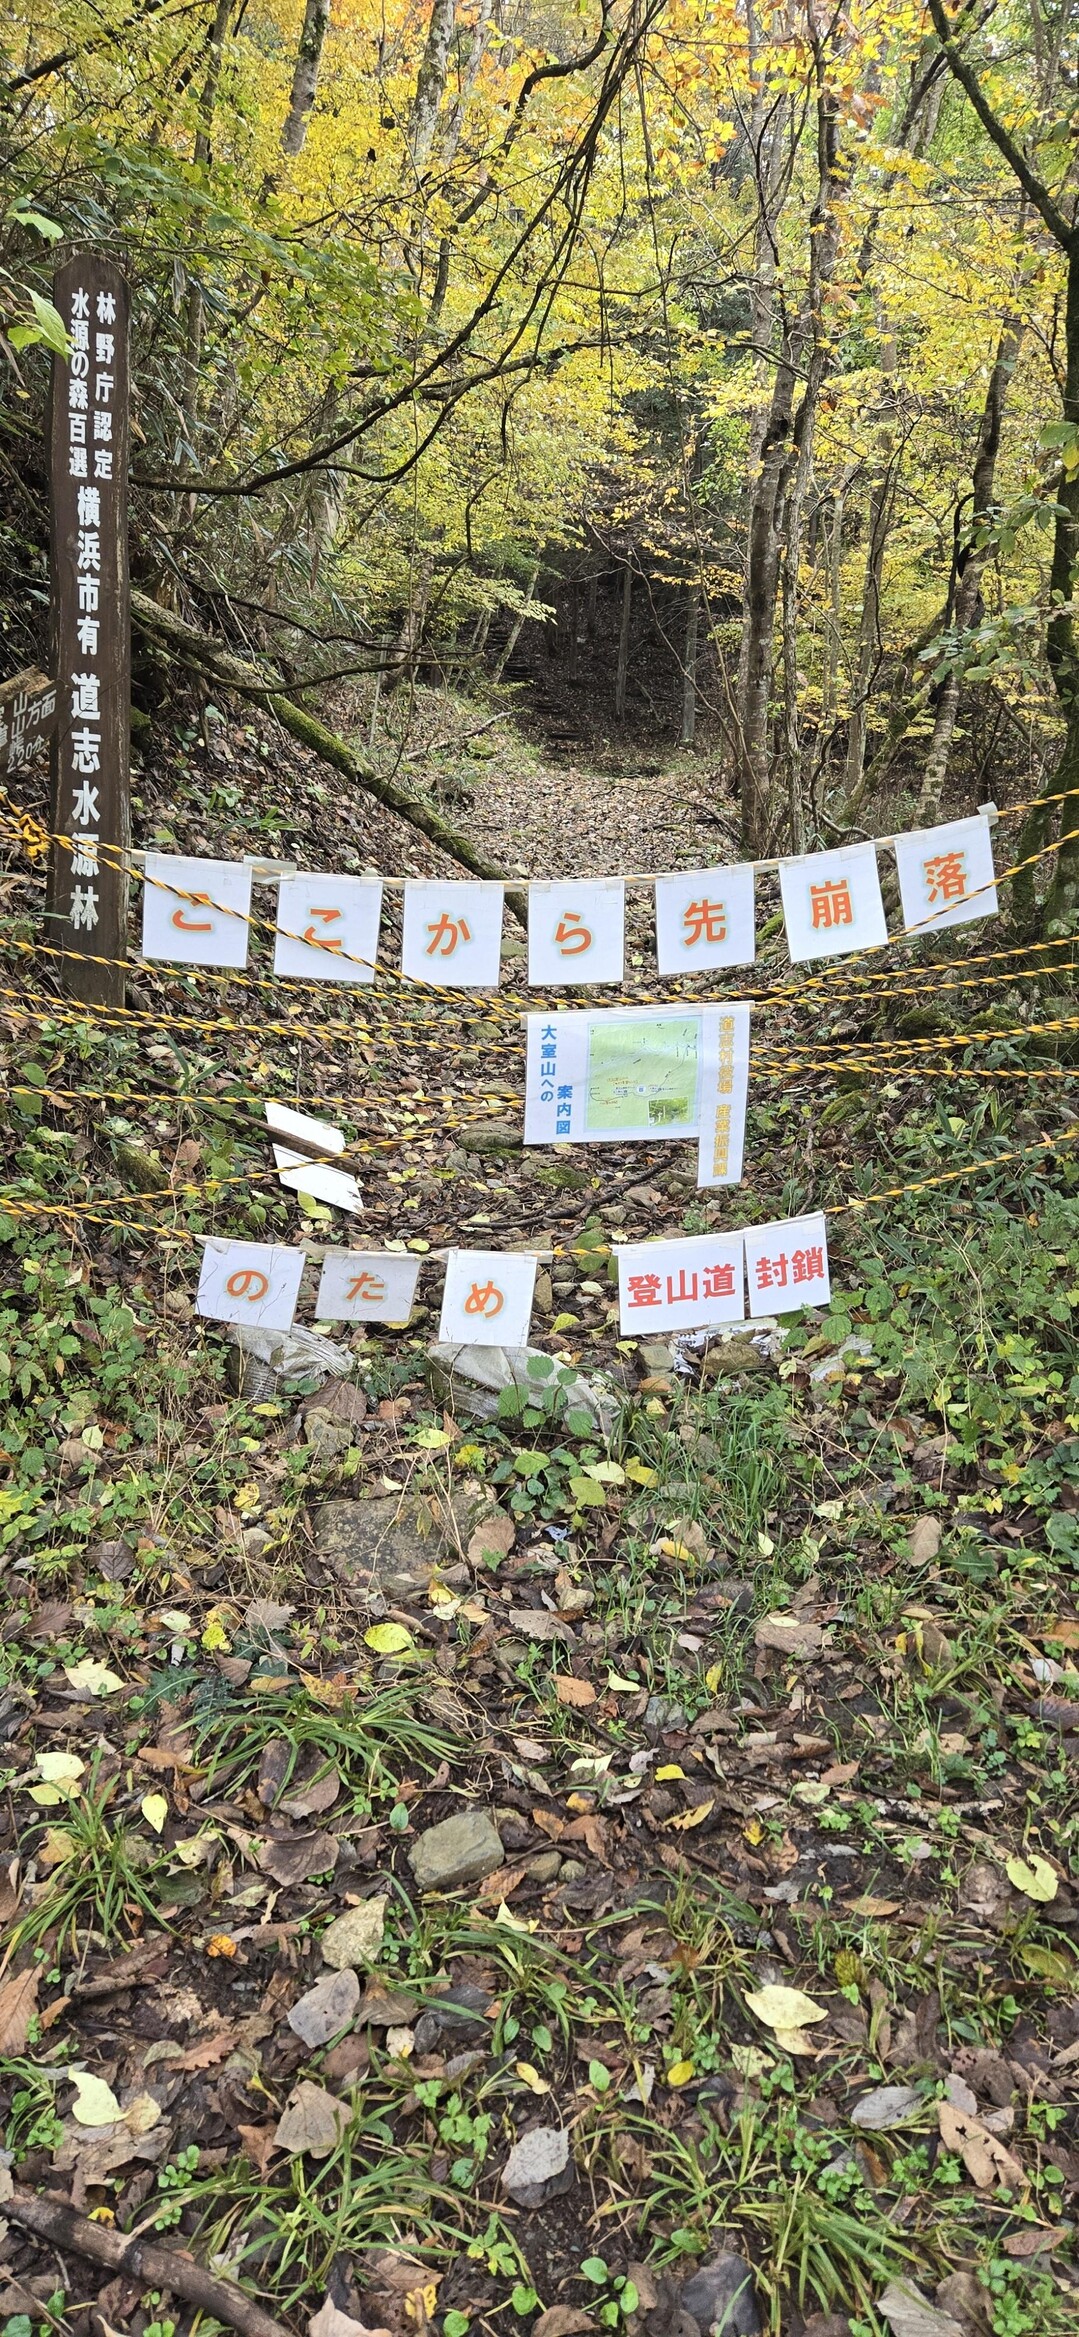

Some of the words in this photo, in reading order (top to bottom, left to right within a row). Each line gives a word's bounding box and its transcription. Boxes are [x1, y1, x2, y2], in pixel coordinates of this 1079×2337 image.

[68, 287, 90, 478] 水源の森百選
[94, 291, 117, 480] 林野庁認定
[76, 485, 101, 656] 横浜市有
[70, 672, 101, 931] 道志水源林
[540, 1024, 557, 1102] 大室山への
[556, 1084, 573, 1136] 案内図
